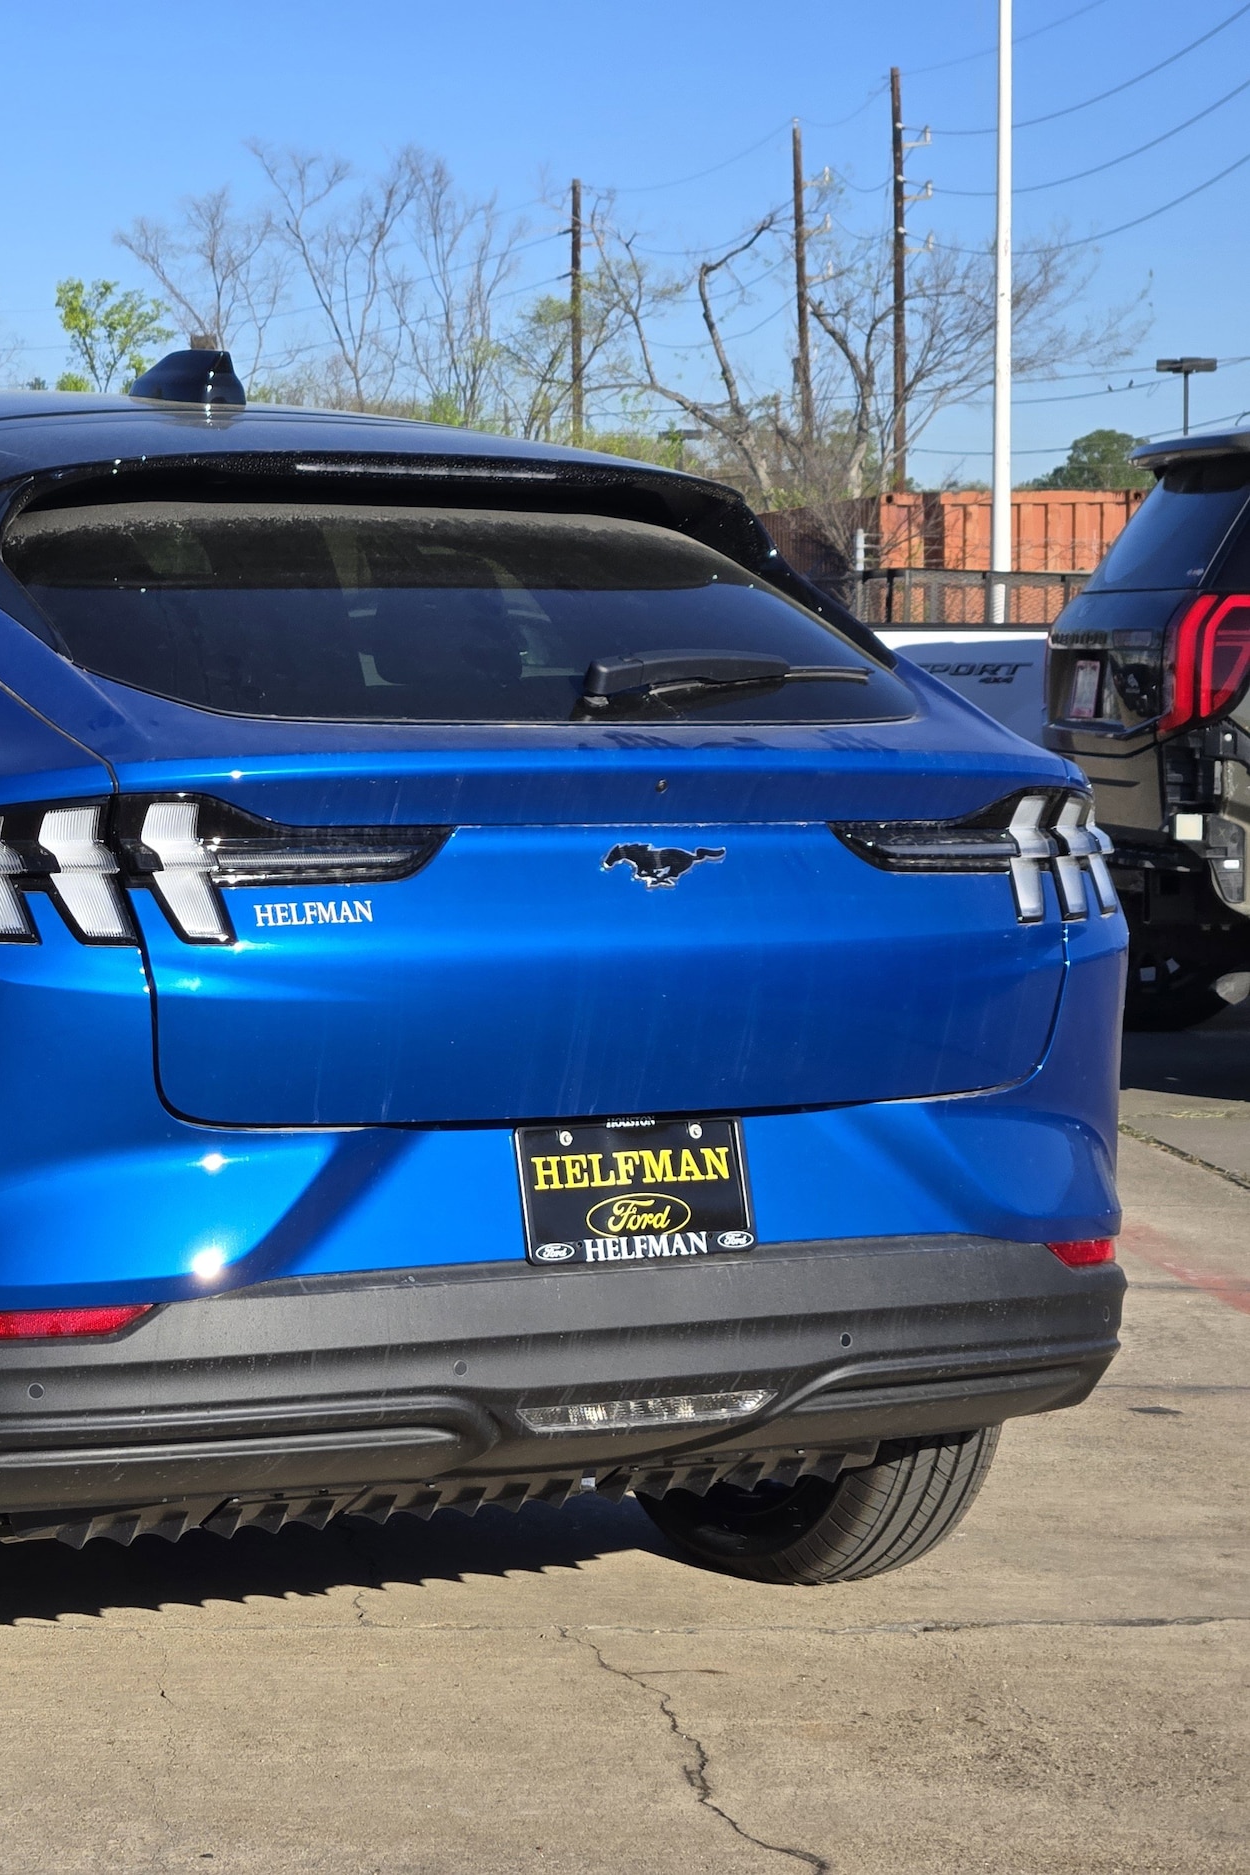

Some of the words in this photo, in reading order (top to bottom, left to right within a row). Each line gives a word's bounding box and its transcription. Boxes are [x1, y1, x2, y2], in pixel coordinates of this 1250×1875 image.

[252, 900, 374, 927] HELFMAN
[605, 1115, 656, 1129] HOUSTON
[530, 1146, 730, 1191] HELFMAN
[607, 1198, 672, 1232] Ford
[541, 1244, 568, 1258] Ford
[584, 1230, 709, 1263] HELFMAN
[722, 1233, 749, 1247] Ford
